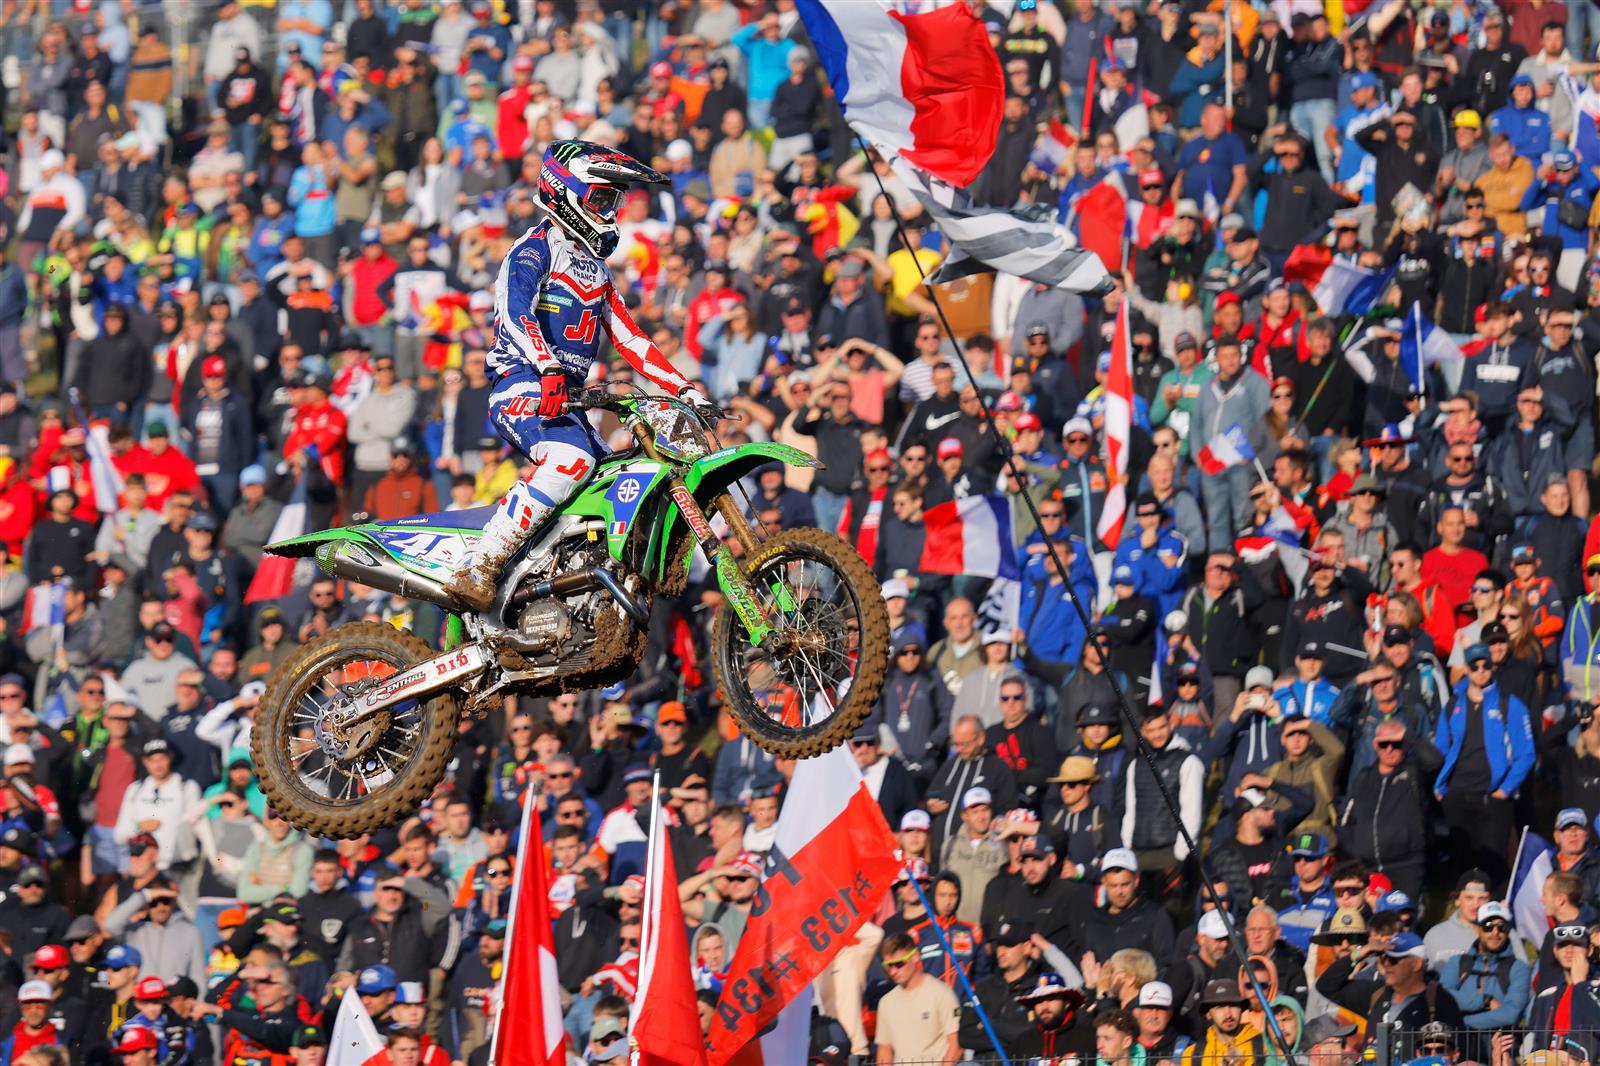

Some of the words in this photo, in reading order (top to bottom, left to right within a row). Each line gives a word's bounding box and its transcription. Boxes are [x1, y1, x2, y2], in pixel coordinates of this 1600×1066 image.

[573, 270, 597, 283] FRANCE
[397, 517, 429, 525] Kawasaki
[387, 532, 438, 557] 4
[748, 545, 786, 573] DUNLOP
